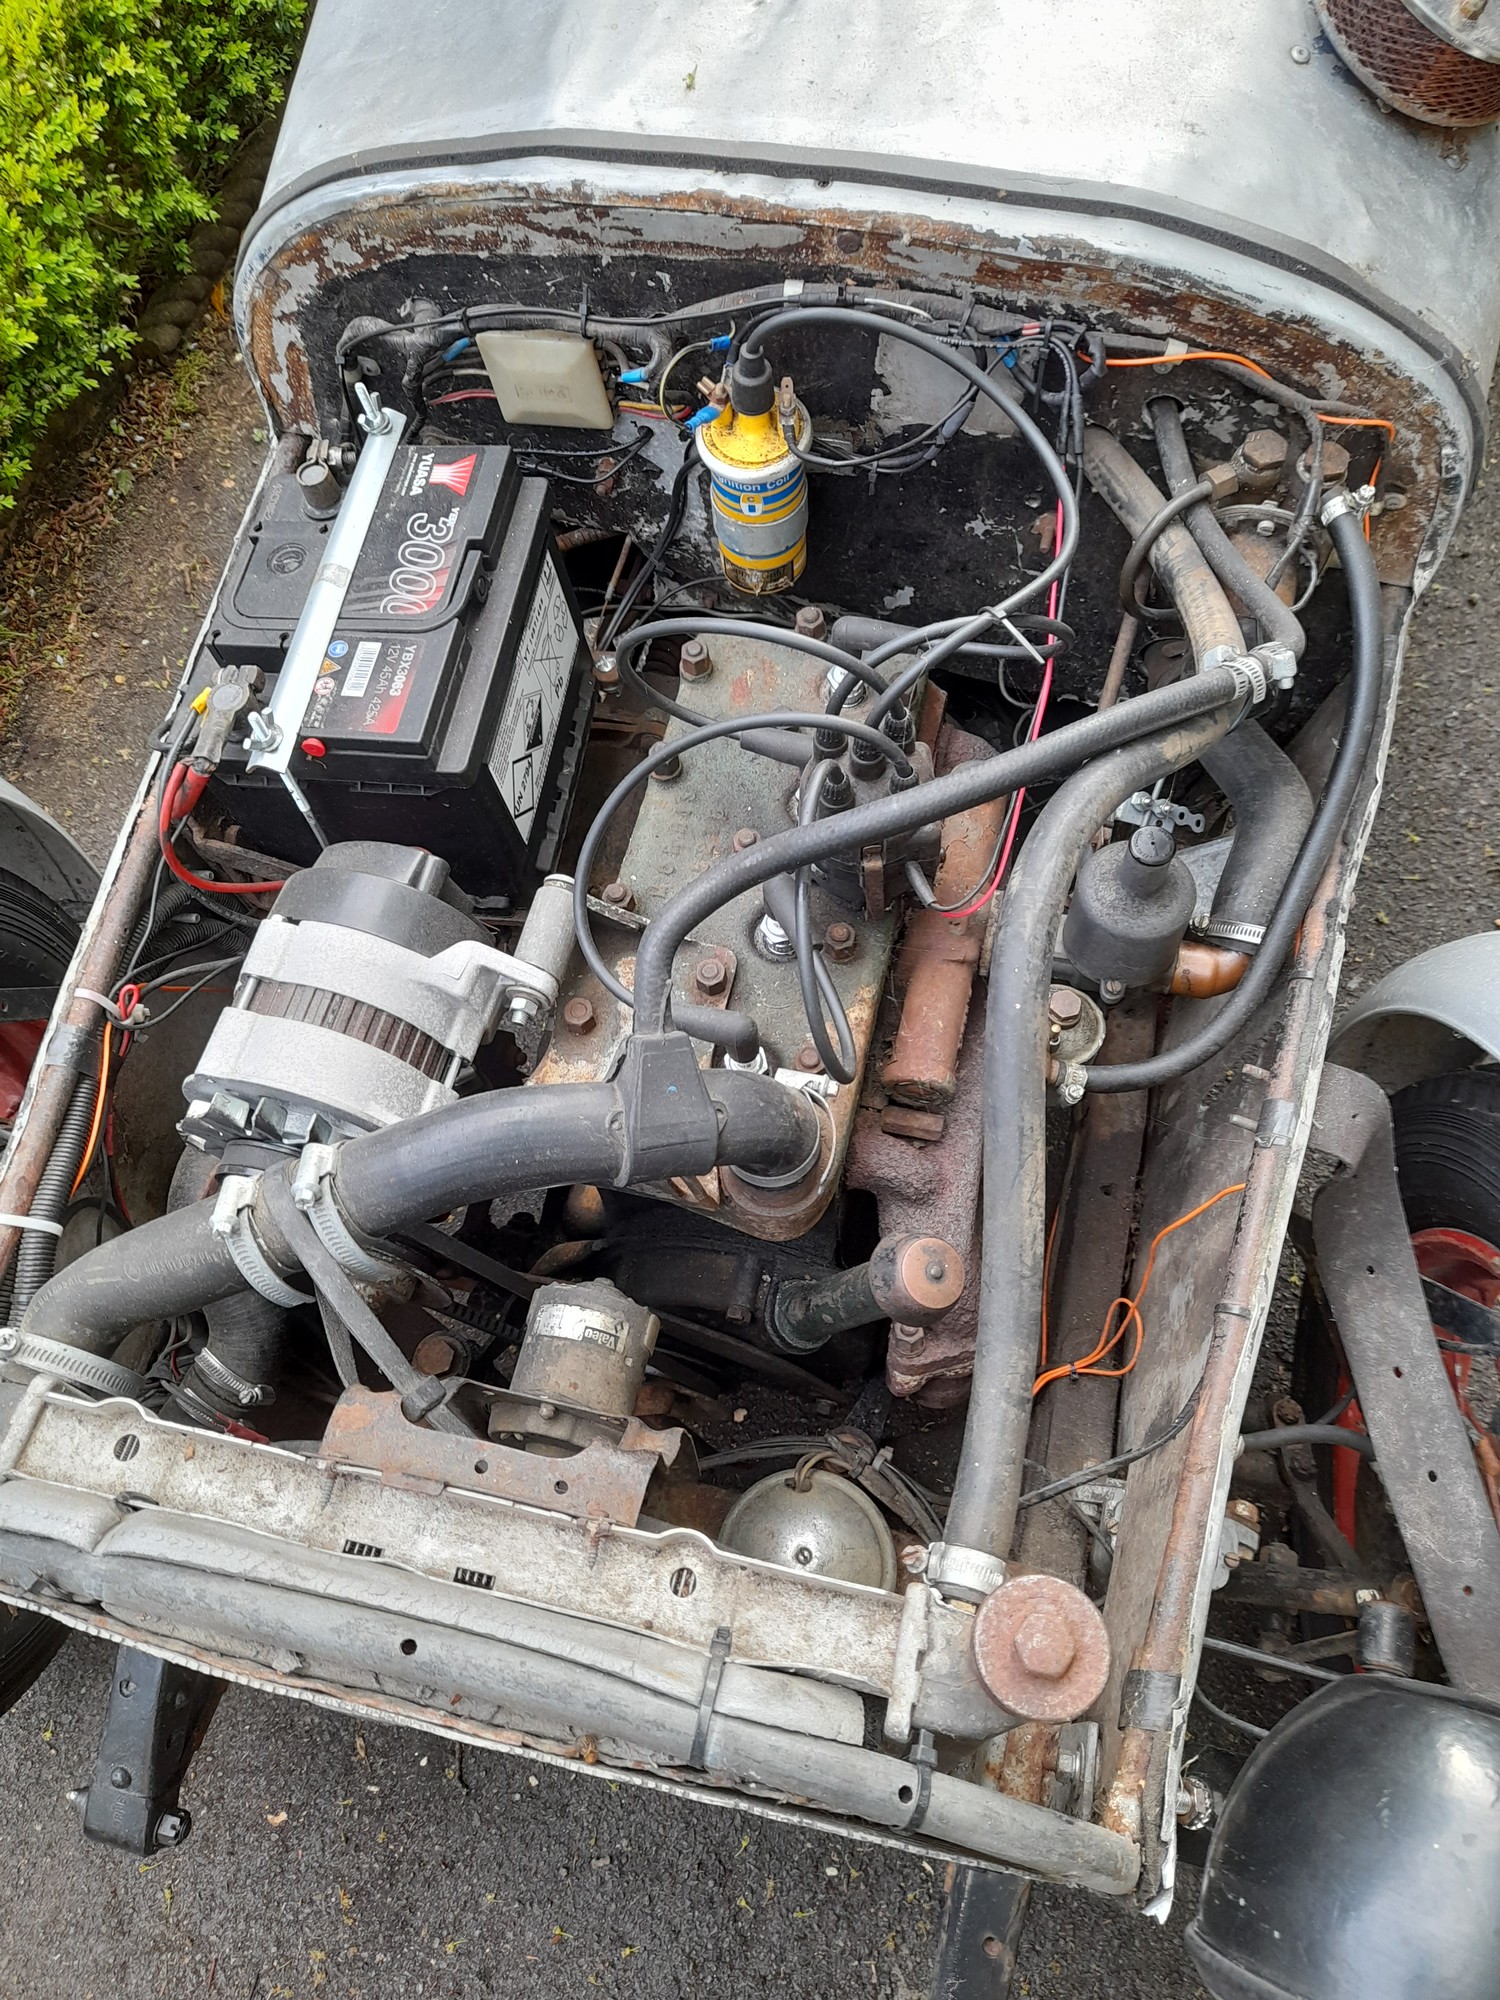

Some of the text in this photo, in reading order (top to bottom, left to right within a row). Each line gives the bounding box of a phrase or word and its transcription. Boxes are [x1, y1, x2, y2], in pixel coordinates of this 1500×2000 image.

[409, 453, 435, 496] YUASA
[717, 473, 790, 491] gnition Coil
[363, 644, 400, 726] 12V 45Ah 425A
[389, 645, 417, 696] YBX3063
[555, 676, 564, 700] Pb
[514, 759, 532, 813] UN 2794
[585, 1328, 616, 1350] Valeo
